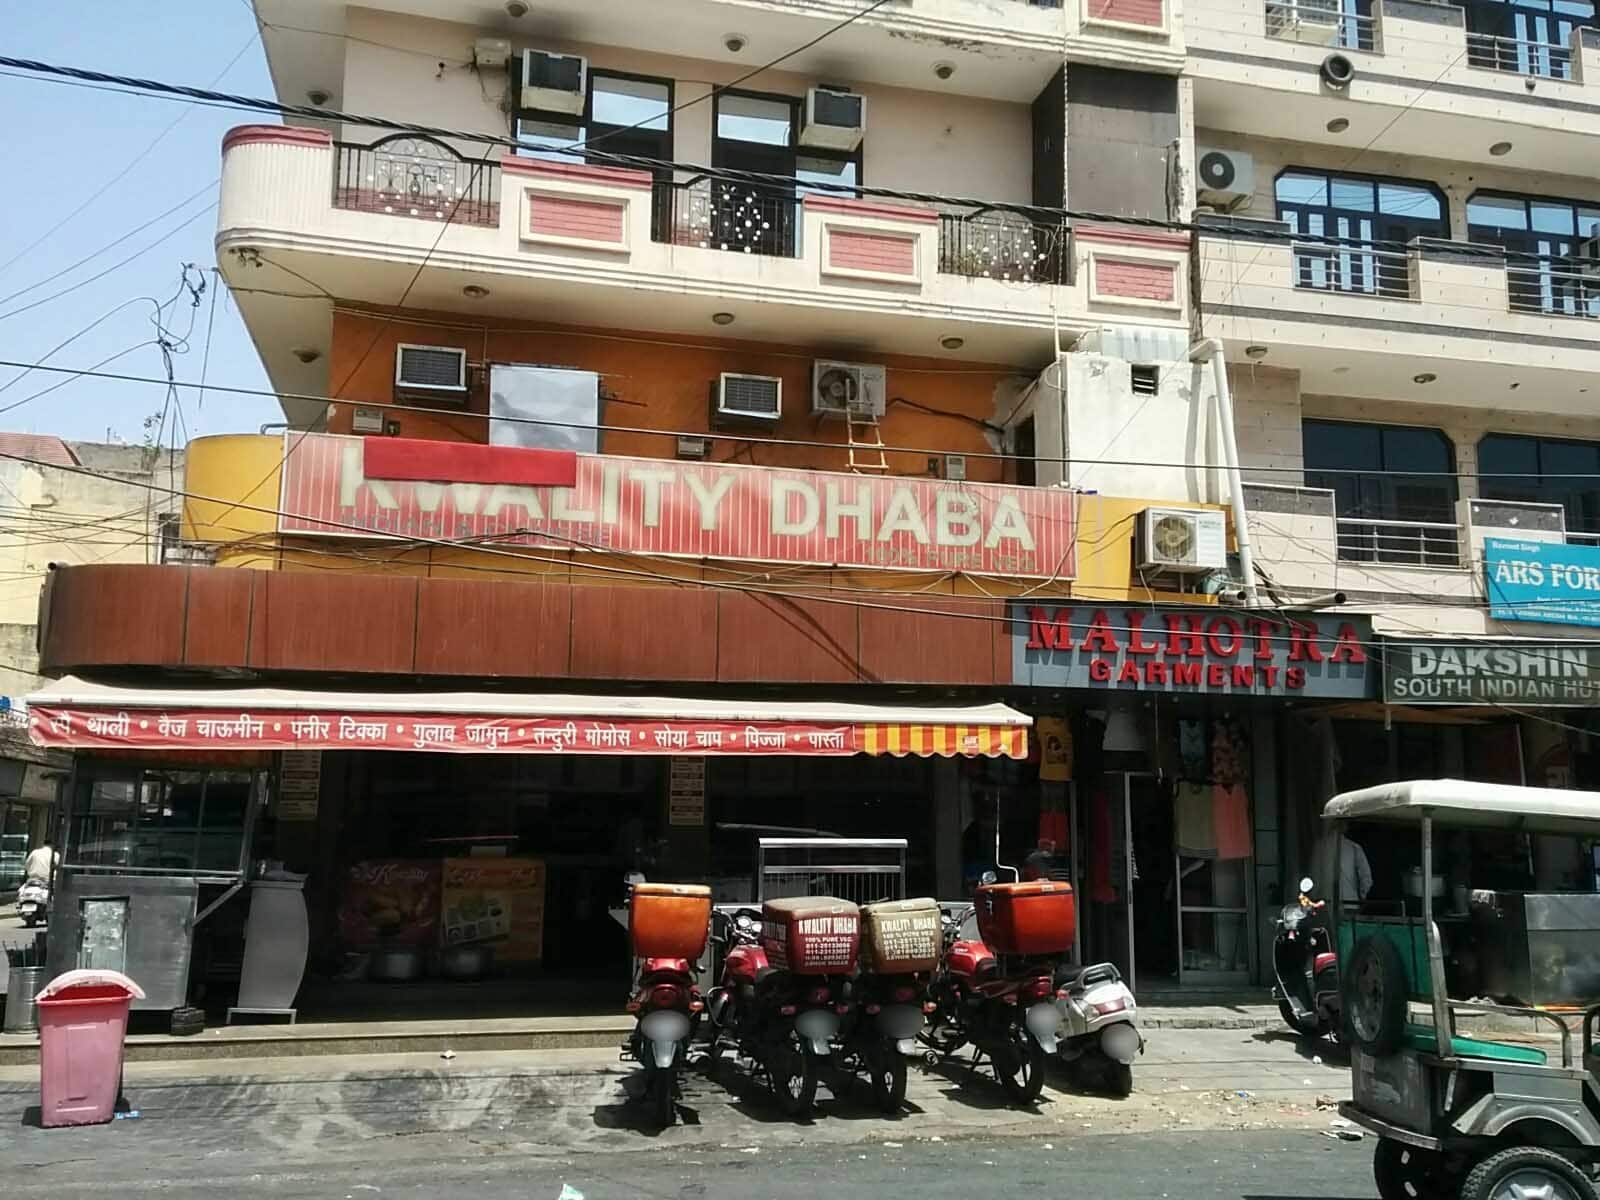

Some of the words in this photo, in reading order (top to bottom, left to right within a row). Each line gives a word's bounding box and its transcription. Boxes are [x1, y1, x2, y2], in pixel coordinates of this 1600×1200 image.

[770, 478, 1036, 552] DHABA
[926, 551, 981, 570] PURE
[1495, 559, 1545, 586] ARS
[1025, 605, 1367, 664] MALHOTRA
[1089, 658, 1306, 689] GARMENTS
[1411, 646, 1588, 677] DAKSHIN
[1393, 678, 1472, 697] SOUTH
[1480, 679, 1554, 698] INDIAN
[86, 711, 131, 737] थाली
[196, 713, 264, 738] चाऊमीन
[291, 716, 331, 740] पनीर
[339, 716, 388, 741] टिक्का
[464, 725, 510, 749] जामुन
[532, 721, 577, 752] तन्दुरी
[584, 722, 632, 747] मोमोस
[653, 725, 688, 748] सोया
[695, 729, 723, 748] चाप
[743, 725, 787, 748] पिज्जा
[807, 731, 846, 749] पास्ता
[798, 917, 832, 935] KWALITY
[833, 917, 858, 935] DHABA
